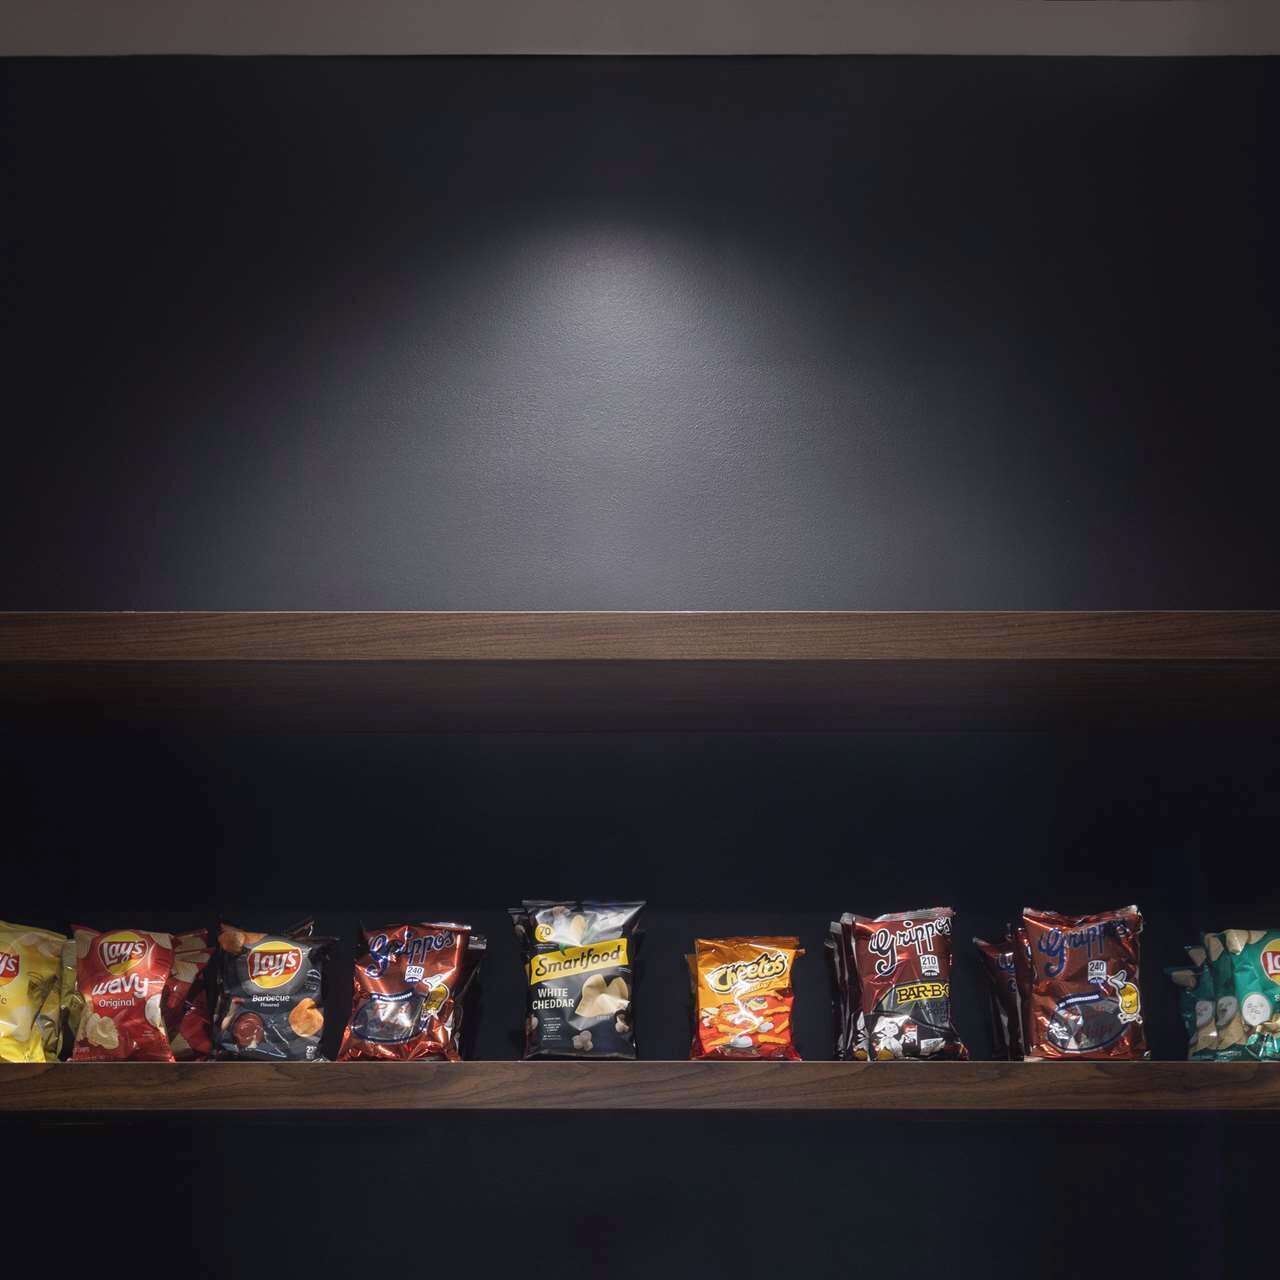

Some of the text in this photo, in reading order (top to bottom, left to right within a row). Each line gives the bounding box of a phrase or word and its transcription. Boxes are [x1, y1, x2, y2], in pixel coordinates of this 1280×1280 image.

[539, 925, 553, 937] 70
[101, 938, 147, 972] Lay's
[535, 944, 623, 978] Smartfood
[921, 956, 937, 967] 210
[250, 949, 298, 979] Lay's
[406, 965, 423, 975] 240
[1089, 961, 1105, 972] 240
[708, 952, 789, 993] Cheetos
[91, 972, 150, 999] wavy
[536, 986, 569, 999] WHITE
[98, 996, 136, 1010] Original
[251, 993, 291, 1003] Barbecue
[532, 997, 576, 1011] CHEDDAR
